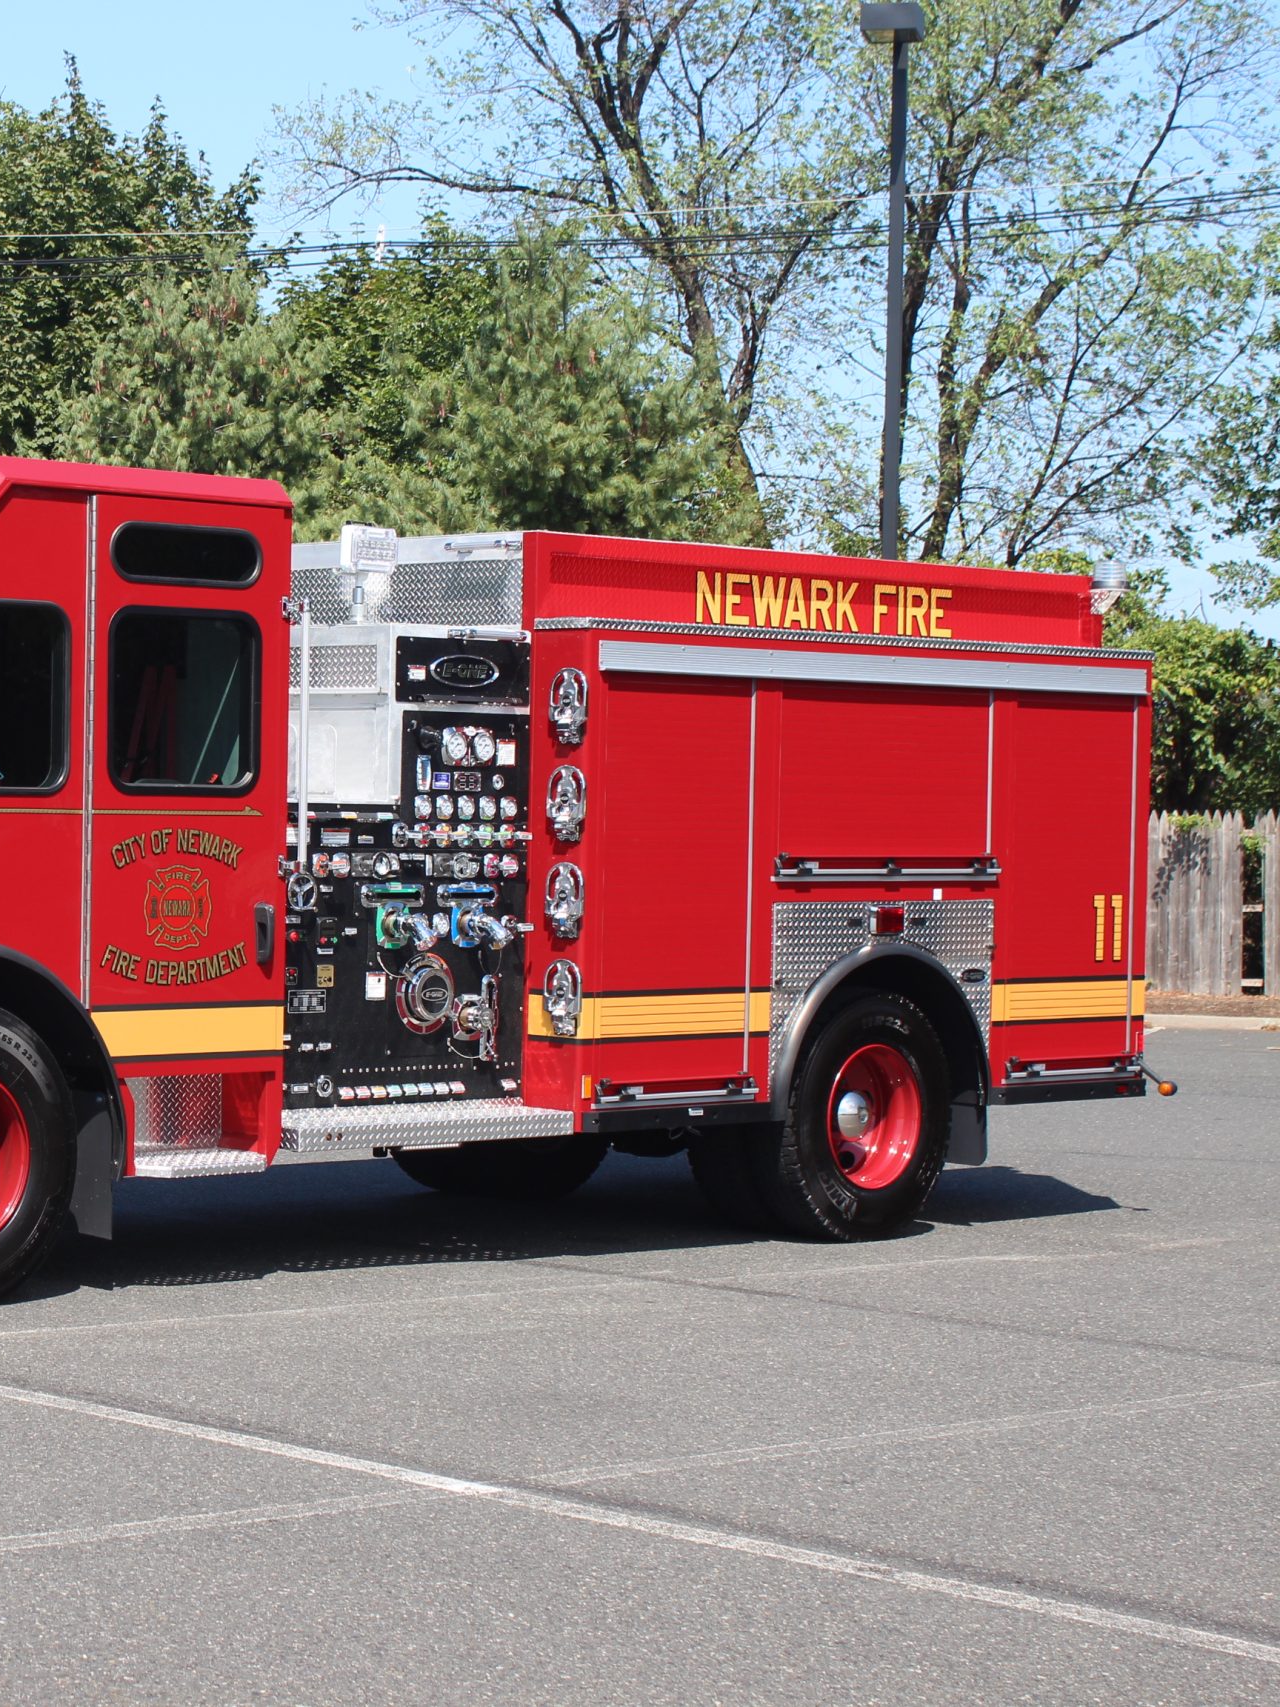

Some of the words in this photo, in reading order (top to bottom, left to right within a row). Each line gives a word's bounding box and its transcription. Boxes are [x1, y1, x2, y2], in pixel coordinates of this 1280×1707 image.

[695, 570, 860, 633] NEWARK
[873, 584, 954, 639] FIRE
[441, 662, 490, 679] E-ONE
[111, 833, 146, 868] CITY
[150, 828, 173, 855] OF
[177, 828, 243, 869] NEWARK
[164, 871, 192, 882] FIRE
[163, 899, 192, 917] NEWARK
[1093, 894, 1123, 962] 11
[101, 944, 142, 980] FIRE
[145, 941, 248, 986] DEPARTMENT
[21, 1048, 39, 1068] 22.5
